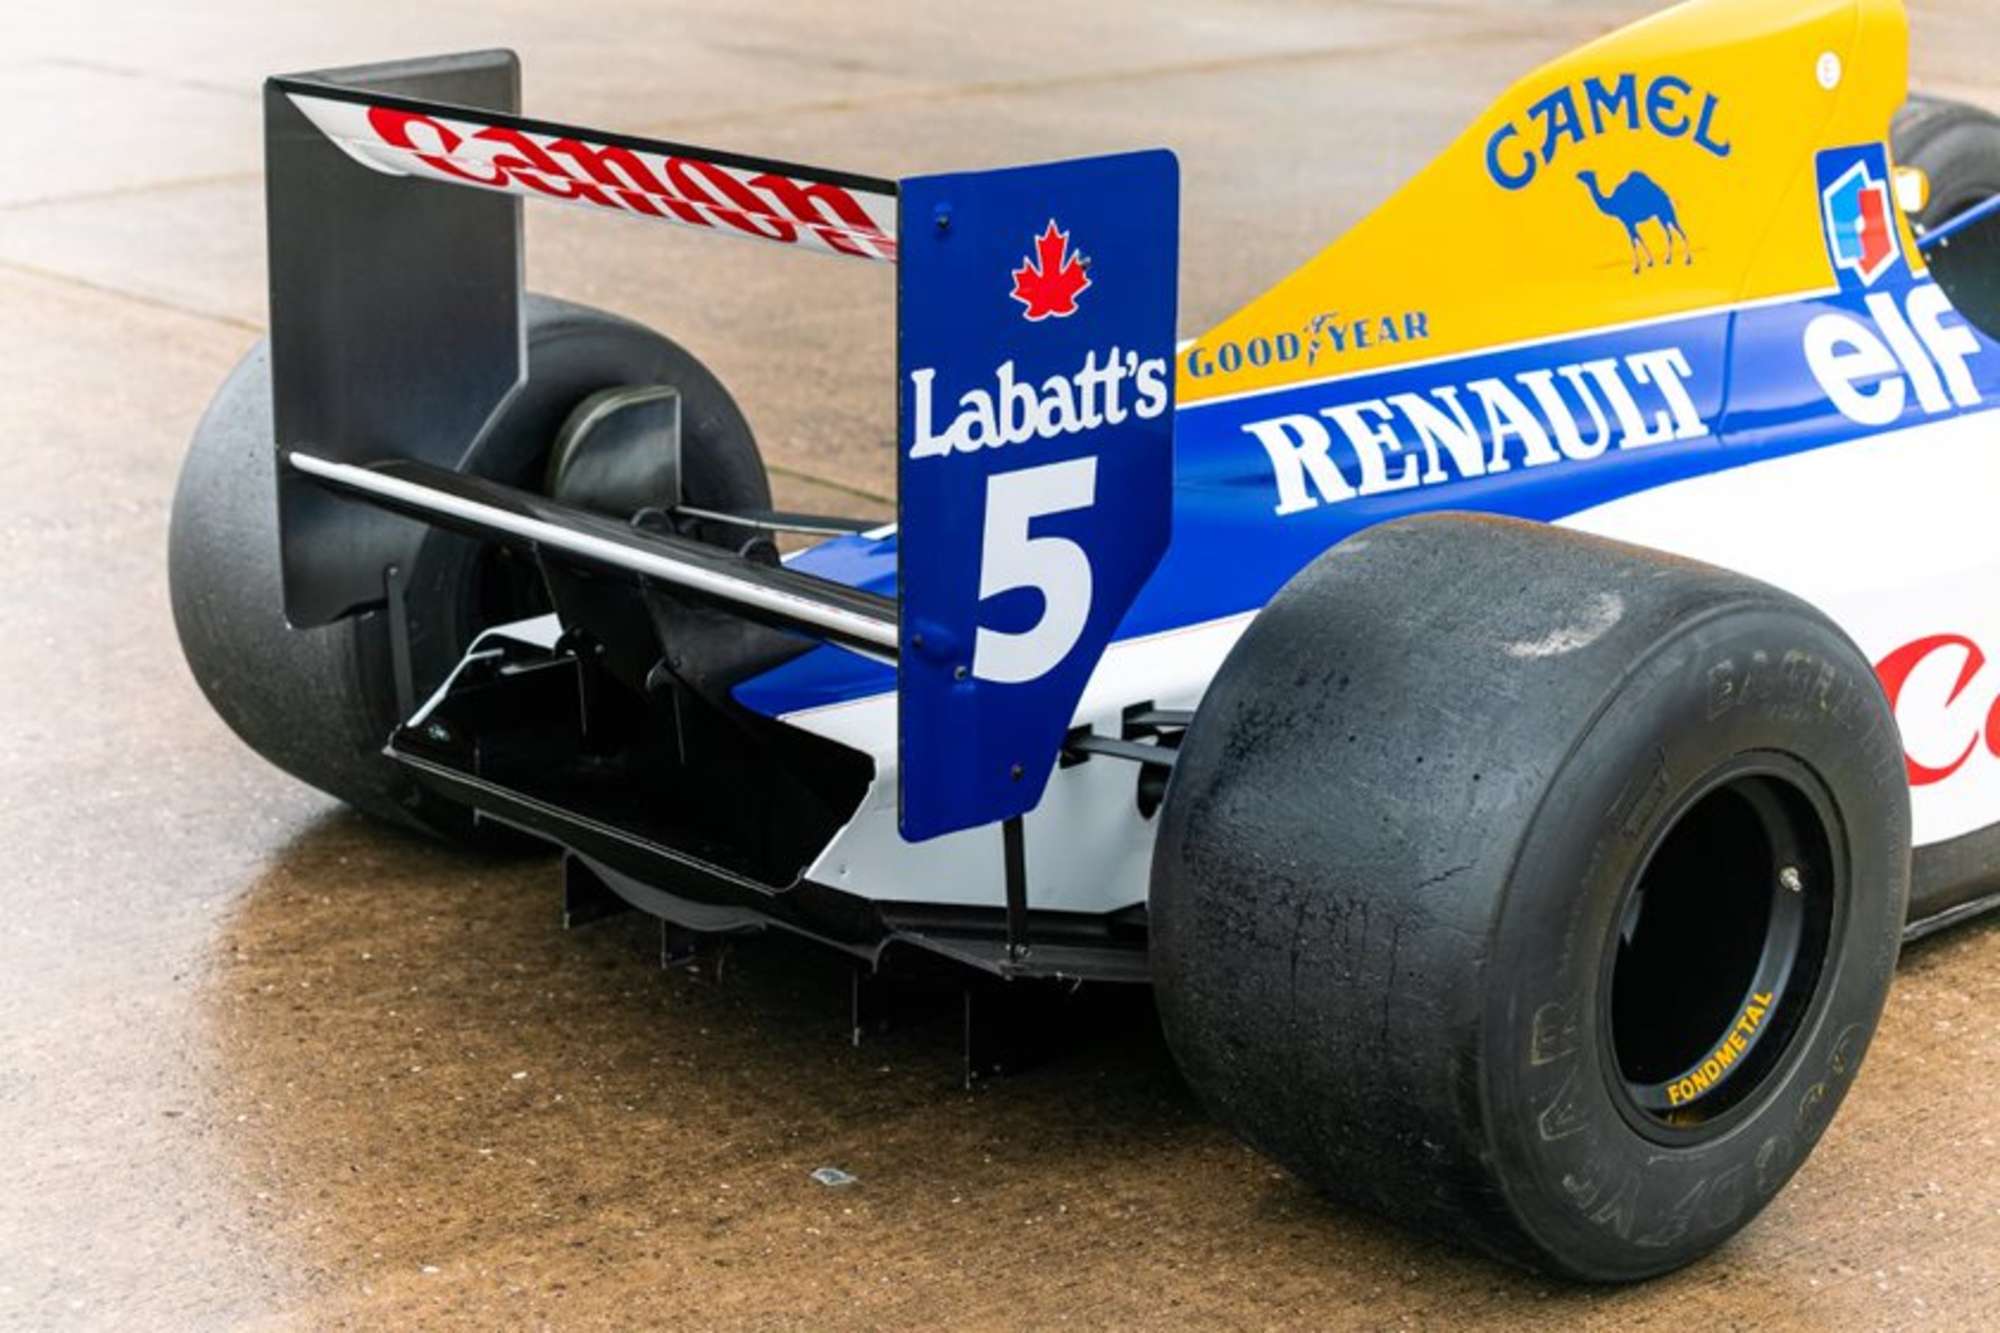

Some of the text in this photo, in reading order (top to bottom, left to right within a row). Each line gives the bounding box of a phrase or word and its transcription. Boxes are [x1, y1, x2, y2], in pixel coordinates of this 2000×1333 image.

[367, 105, 897, 261] Canon
[1486, 73, 1731, 191] CAMEL
[909, 346, 1167, 459] Labatt's
[1803, 283, 1982, 427] elf
[1242, 347, 1710, 515] RENAULT
[972, 456, 1097, 683] 5
[1666, 990, 1774, 1106] FONDMETAL
